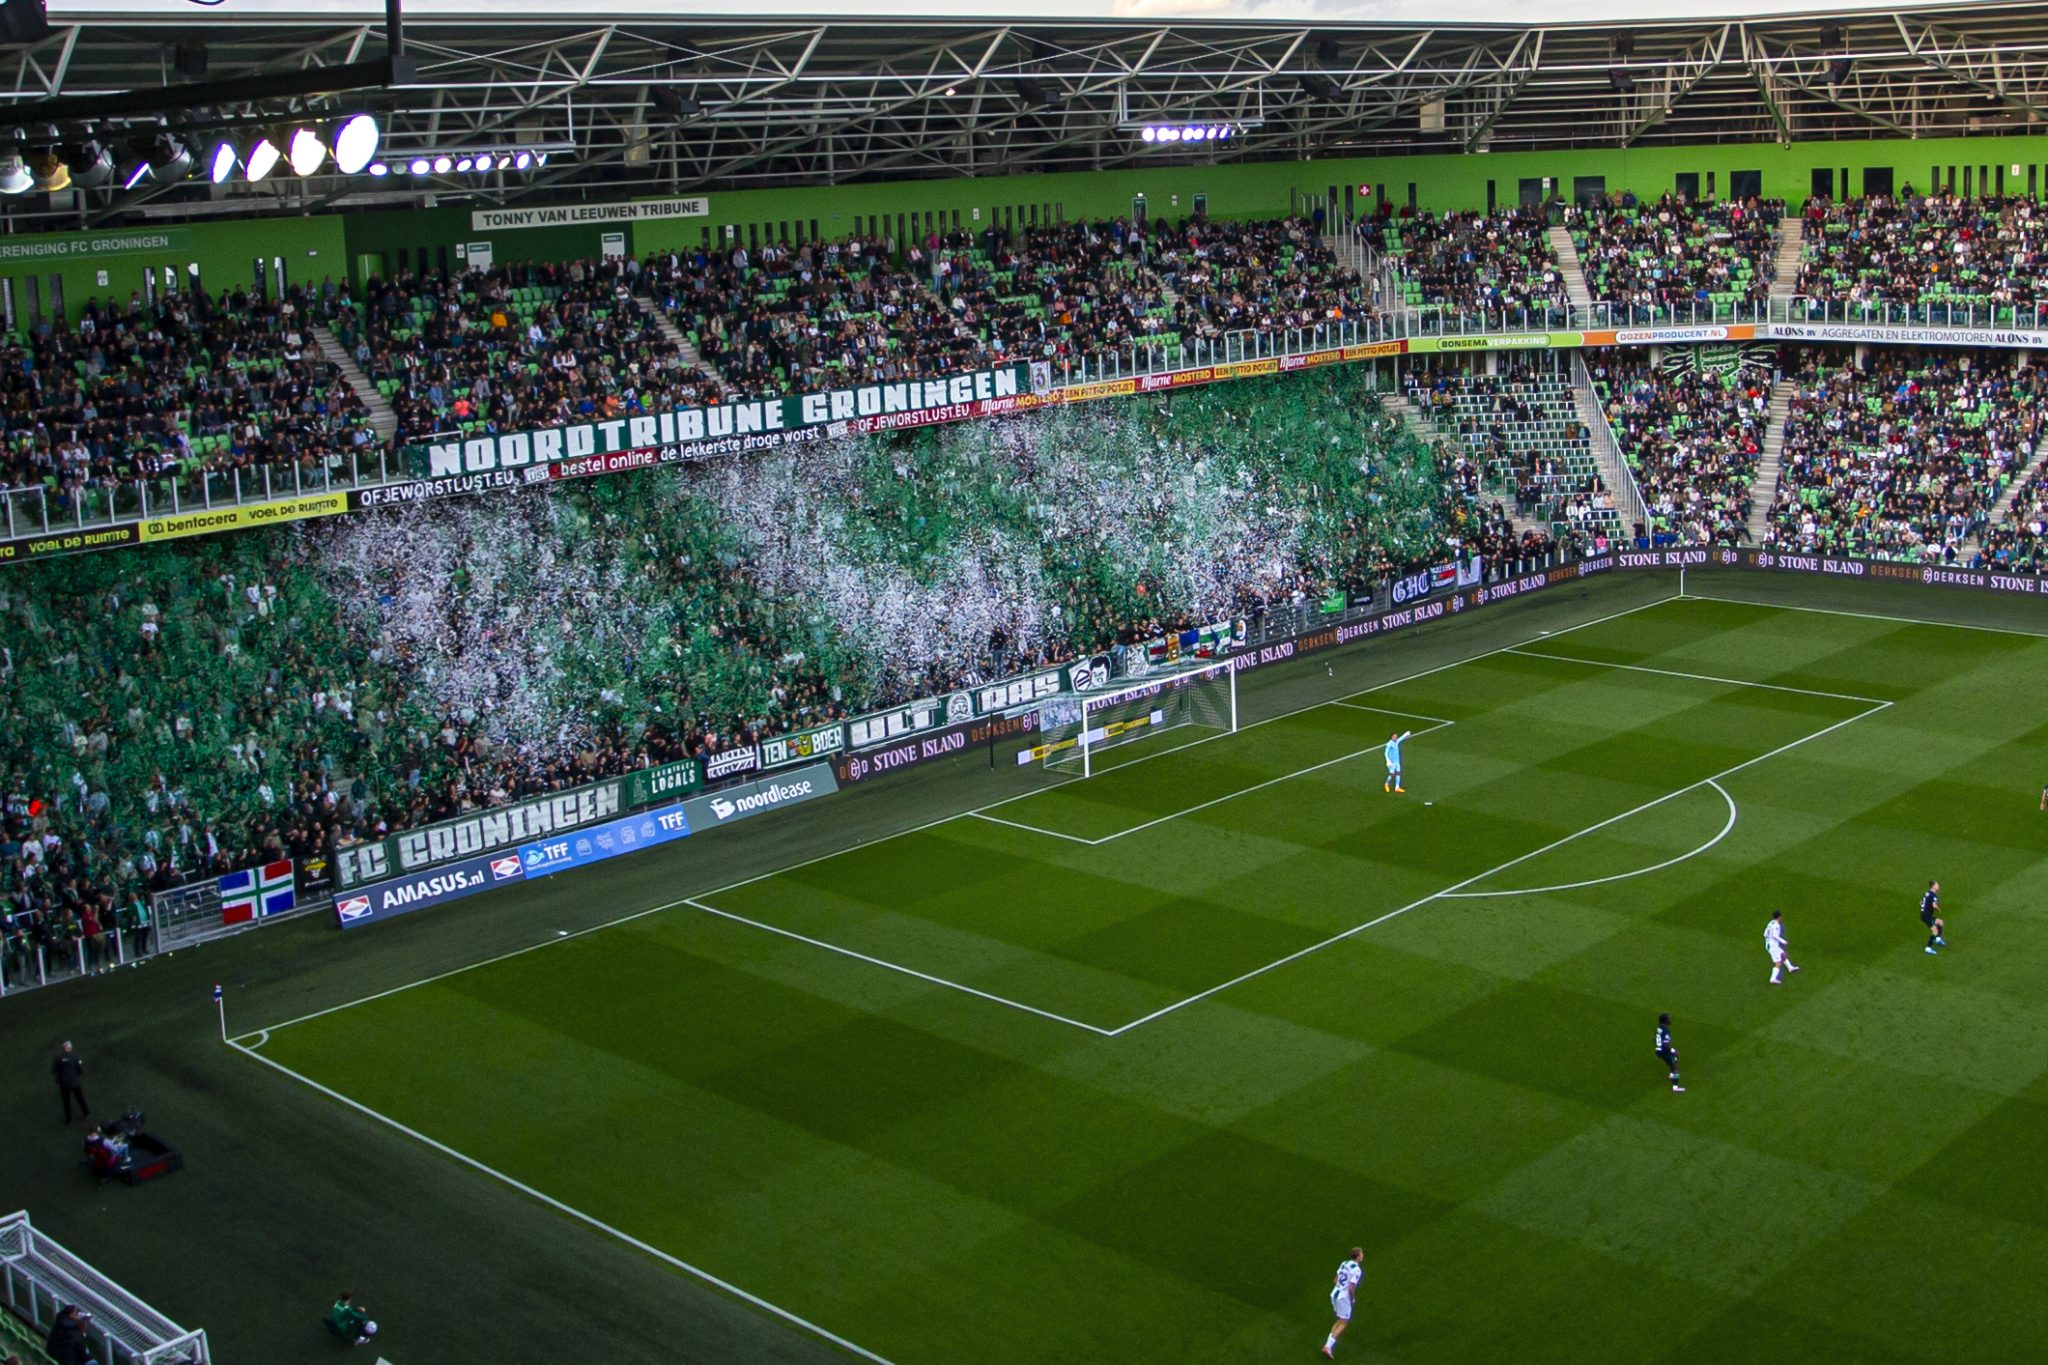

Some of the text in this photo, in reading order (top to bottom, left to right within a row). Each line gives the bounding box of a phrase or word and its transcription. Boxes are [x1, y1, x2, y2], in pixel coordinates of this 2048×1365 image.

[484, 201, 700, 228] TONNY VAN LEEUWEN TRIBUNE
[71, 241, 88, 252] FC
[91, 236, 169, 251] GRONINGEN
[1620, 329, 1723, 341] DOZENPRODUCENT.NL
[1773, 326, 1804, 337] ALONS
[1821, 328, 1993, 343] AGGREGATEN EN ELEKTROMOTOREN
[1994, 333, 2029, 344] ALONS
[1306, 351, 1341, 365] MOSTERD
[1172, 369, 1211, 385] MOSTERD
[429, 368, 1017, 477] NOORDTRIBUNE GRONINGEN
[660, 426, 820, 462] de lekkerste droge worst
[560, 449, 653, 477] bestel online
[167, 512, 237, 532] bentacera
[1585, 556, 1613, 573] DERKSEN
[1619, 550, 1707, 567] STONE ISLAND
[1778, 554, 1864, 576] STONE ISLAND
[1870, 564, 1919, 579] DERKSEN
[1933, 572, 1984, 586] DERKSEN
[1990, 575, 2035, 593] STONE
[1490, 573, 1546, 600] STONE ISLAND
[1382, 602, 1443, 631] STONE ISLAND
[1299, 631, 1335, 652] DERKSEN
[1344, 620, 1379, 639] DERKSEN
[1260, 641, 1294, 664] ISLAND
[763, 728, 842, 764] TEN BOER
[874, 732, 965, 771] STONE ISLAND
[707, 756, 755, 779] RAGAZZI
[651, 769, 695, 795] LOCALS
[736, 780, 813, 813] noordlease
[657, 811, 685, 831] TFF
[337, 783, 619, 887] FC GRONINGEN
[543, 842, 569, 860] TFF
[382, 870, 485, 910] AMASUS.nl
